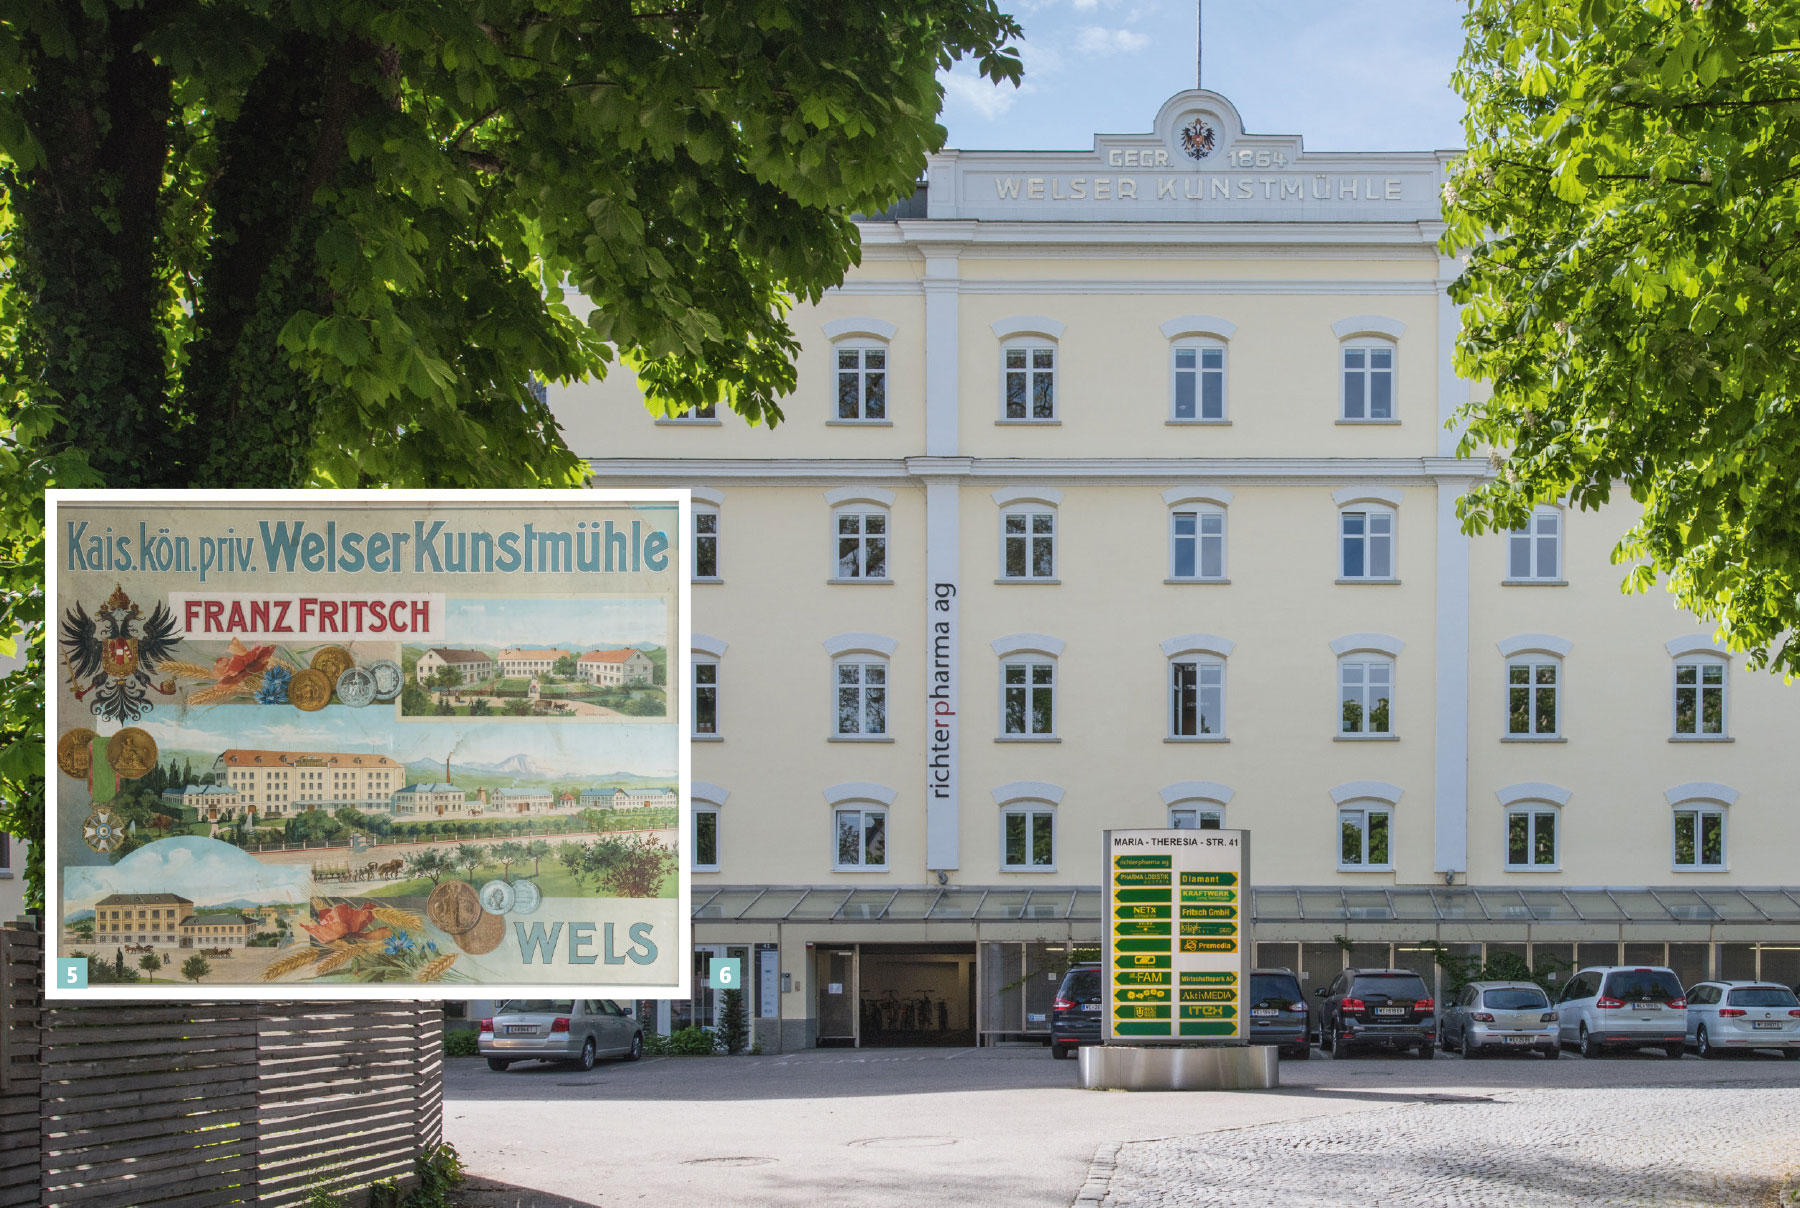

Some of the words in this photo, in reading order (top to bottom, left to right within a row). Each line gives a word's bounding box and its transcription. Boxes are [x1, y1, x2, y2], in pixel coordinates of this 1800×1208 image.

[1109, 150, 1174, 168] GEGR.
[1228, 150, 1288, 168] 1864
[995, 177, 1139, 200] WELSER
[1157, 174, 1402, 201] KUNSTMÜHLE
[257, 520, 411, 573] Welser
[412, 520, 669, 573] Kunstmühle
[935, 583, 956, 612] ag
[185, 600, 293, 633] FRANZ
[299, 598, 430, 633] FRITSCH
[929, 622, 956, 798] richterpharma
[1114, 838, 1144, 846] MARIA
[1151, 838, 1198, 846] THERESIA
[1206, 838, 1227, 846] STR.
[1229, 838, 1238, 846] 41
[1182, 875, 1219, 883] Diamant
[1182, 908, 1207, 916] Fritsch
[1208, 908, 1230, 916] GmbH
[514, 922, 658, 965] WELS
[1137, 972, 1162, 983] FAM
